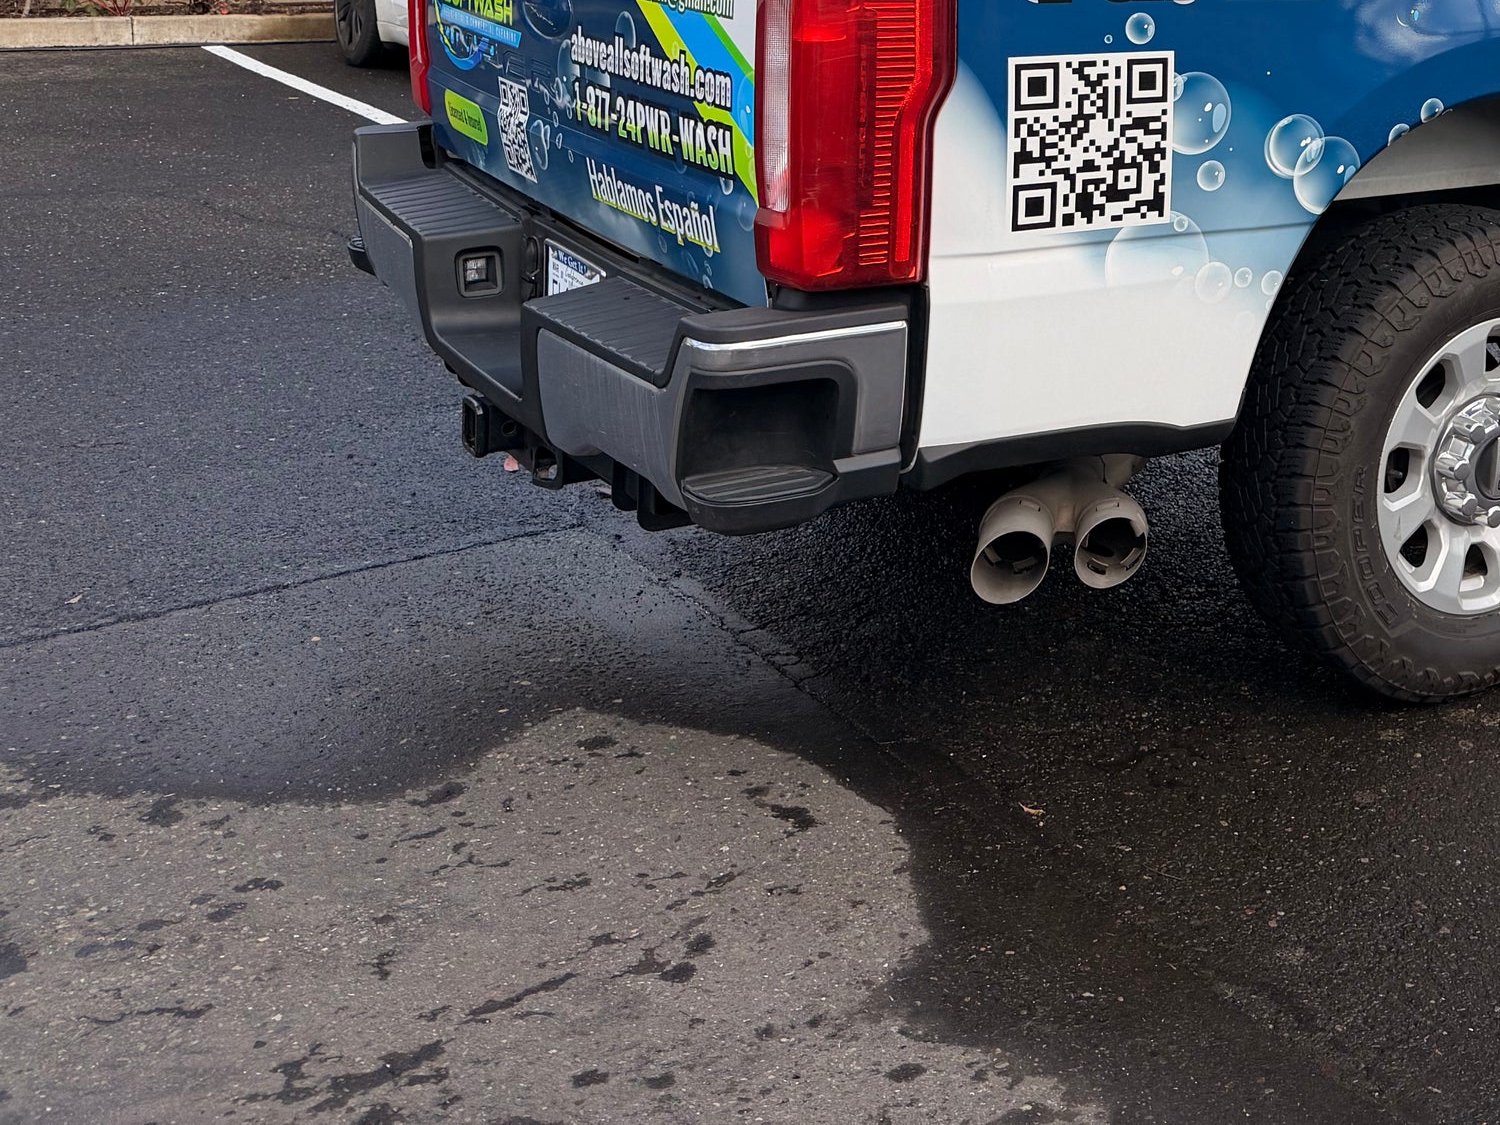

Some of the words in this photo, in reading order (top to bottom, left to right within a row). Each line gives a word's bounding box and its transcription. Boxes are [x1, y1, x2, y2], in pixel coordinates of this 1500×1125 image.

[570, 25, 732, 108] aboveallsoftwash.com
[574, 81, 734, 175] 1-877-24PWR-WASH
[586, 157, 658, 226] Hablamos
[655, 185, 721, 253] Español
[1352, 466, 1398, 624] COOPER
